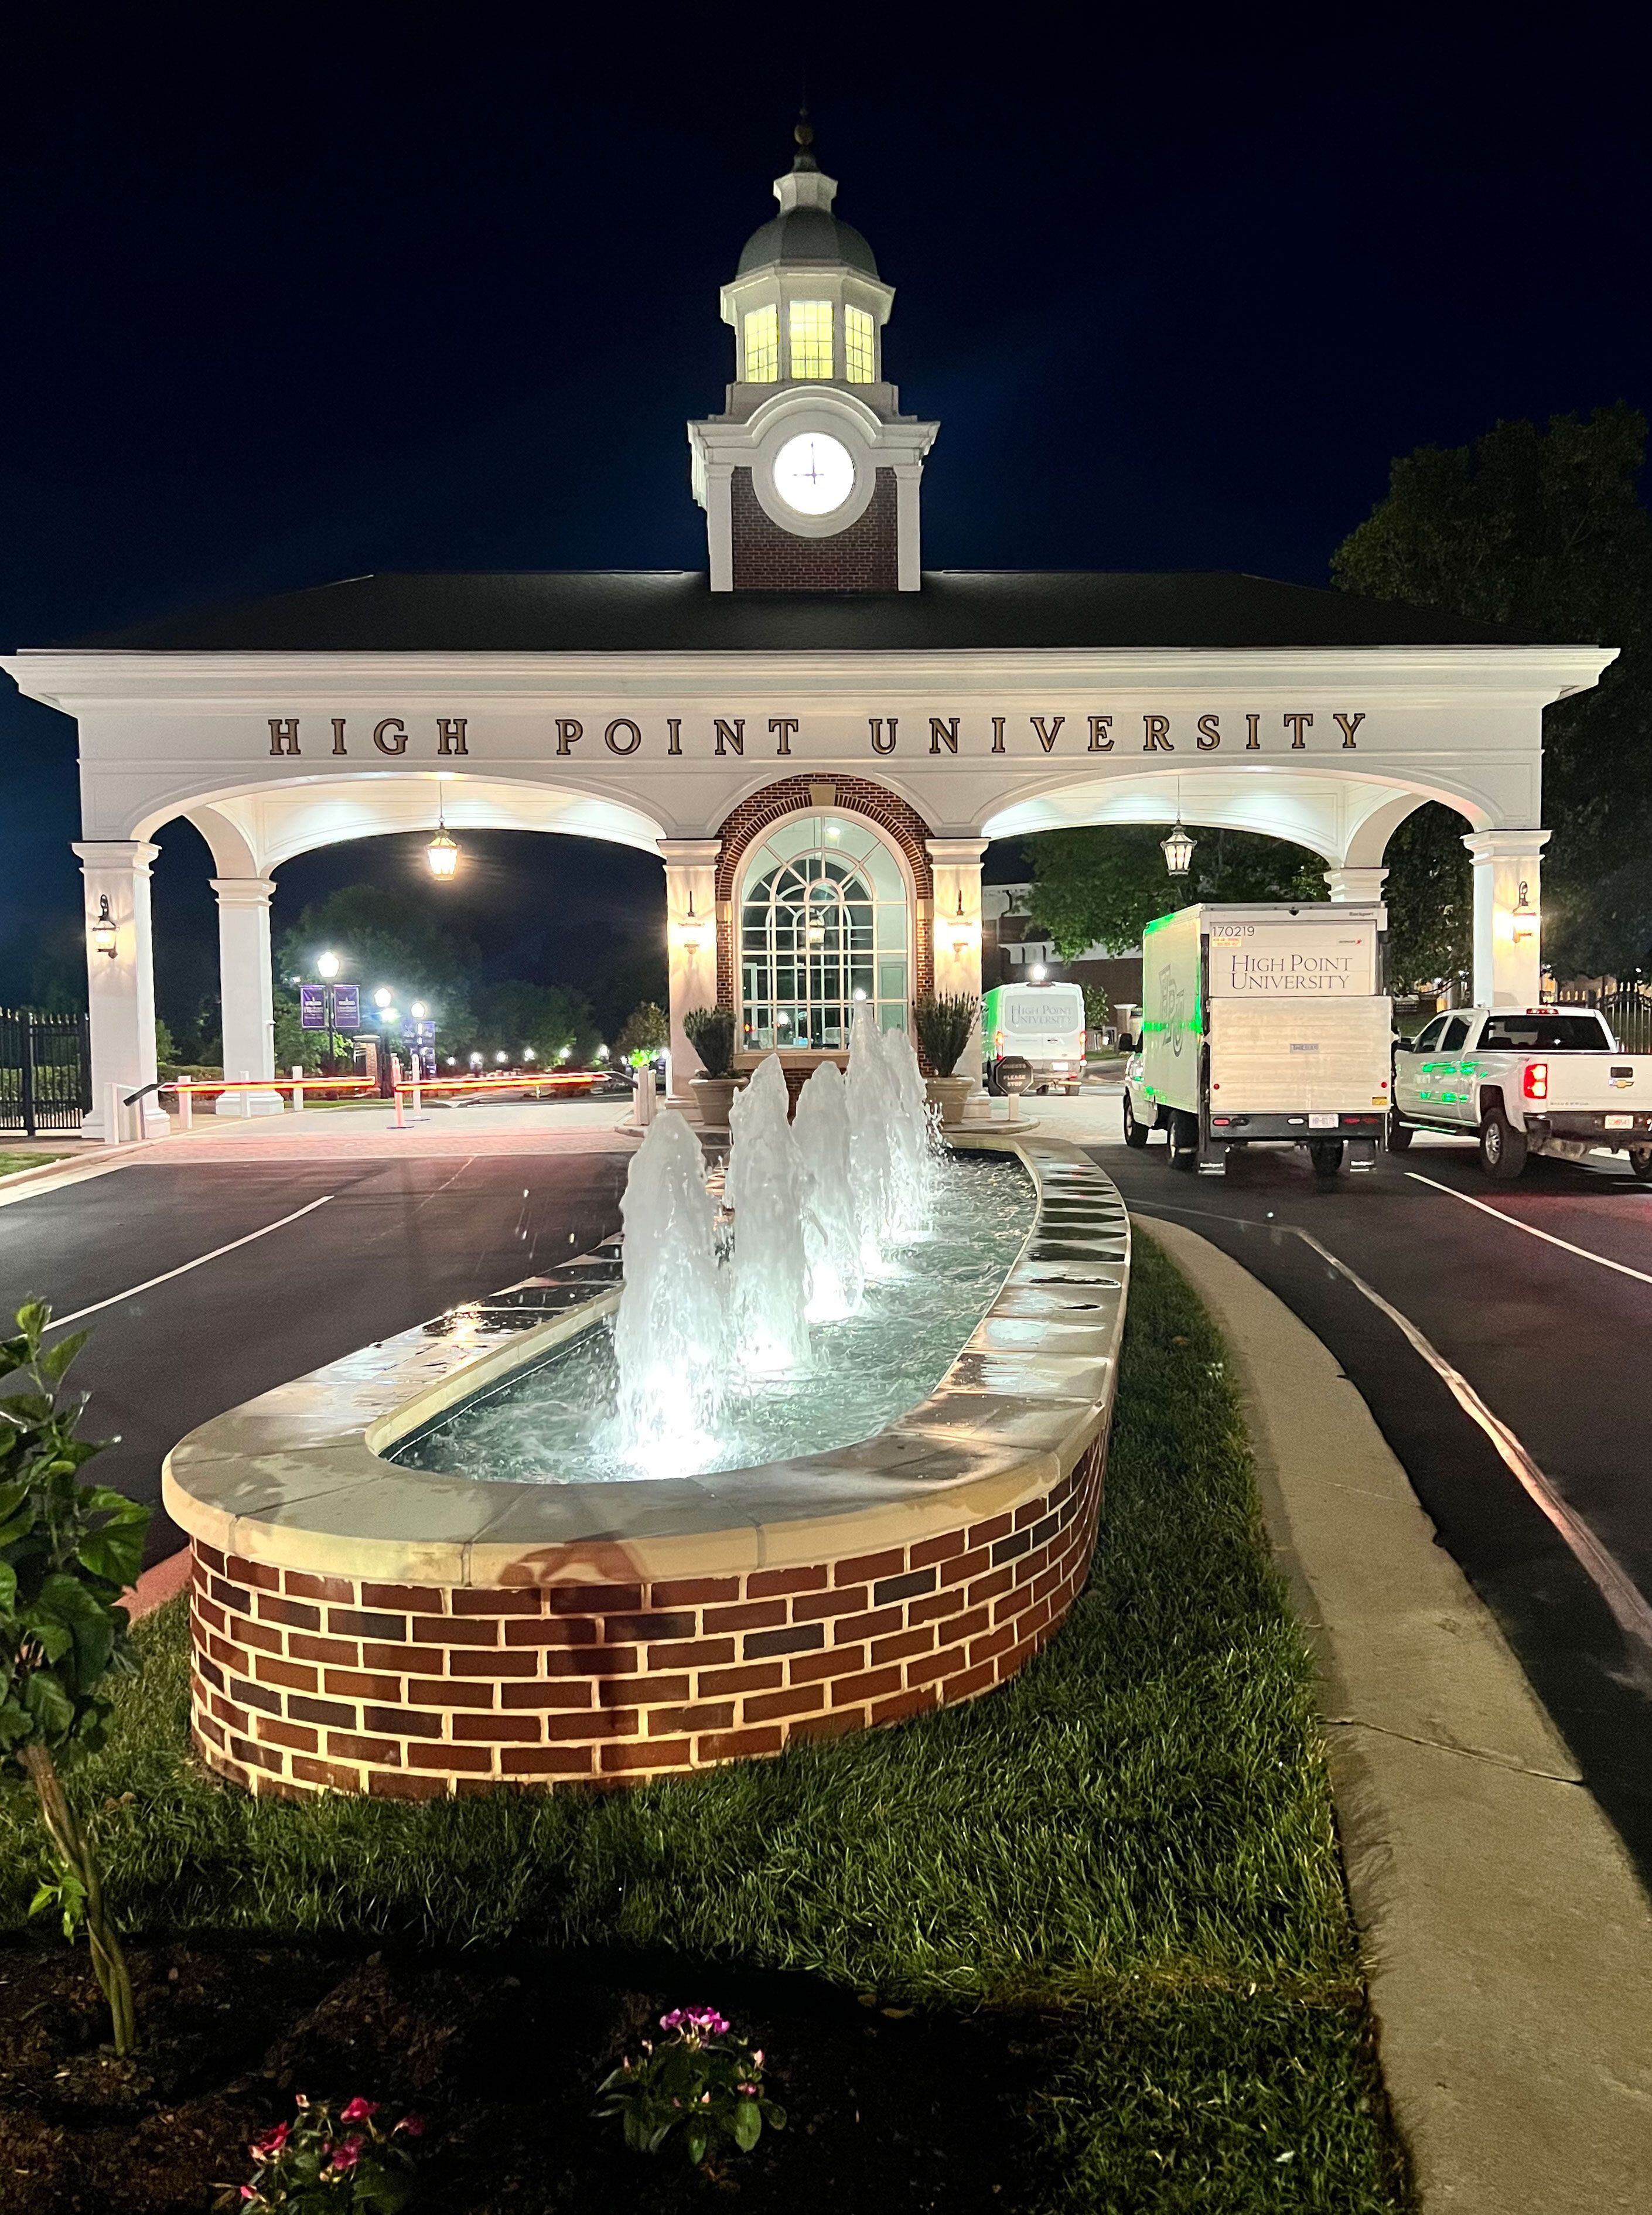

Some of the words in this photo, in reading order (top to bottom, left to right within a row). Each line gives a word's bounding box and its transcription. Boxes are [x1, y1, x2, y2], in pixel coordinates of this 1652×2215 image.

[268, 718, 469, 755] HIGH
[555, 718, 798, 756] POINT
[869, 713, 1366, 755] UNIVERSITY
[1212, 926, 1255, 937] 170219
[1231, 955, 1285, 972] HIGH
[1291, 954, 1353, 972] POINT
[1231, 973, 1350, 990] UNIVERSITY
[1011, 1005, 1039, 1014] HIGH
[1043, 1004, 1072, 1014] POINT
[1011, 1014, 1072, 1024] UNIVERSITY
